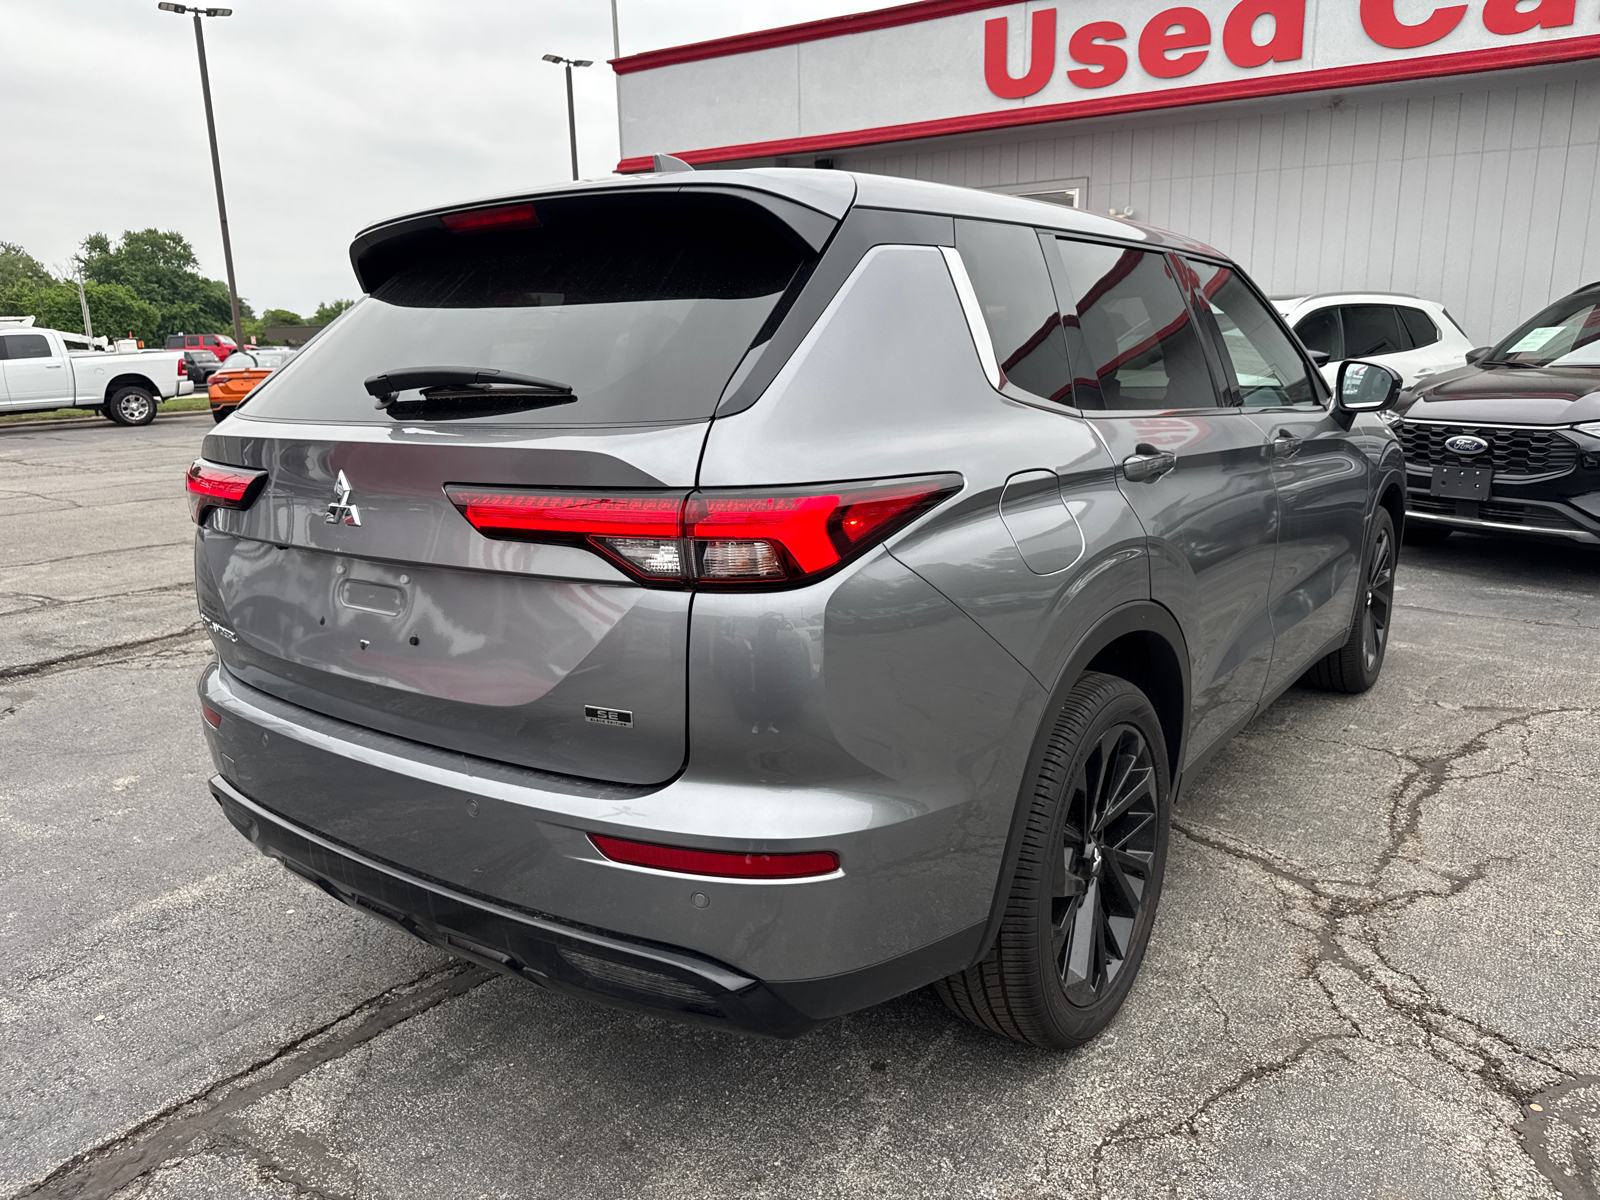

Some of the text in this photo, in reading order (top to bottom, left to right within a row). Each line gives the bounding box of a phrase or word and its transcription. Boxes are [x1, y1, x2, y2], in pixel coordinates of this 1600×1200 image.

[984, 0, 1304, 99] Used
[1453, 439, 1478, 451] Ford
[597, 710, 618, 720] SE
